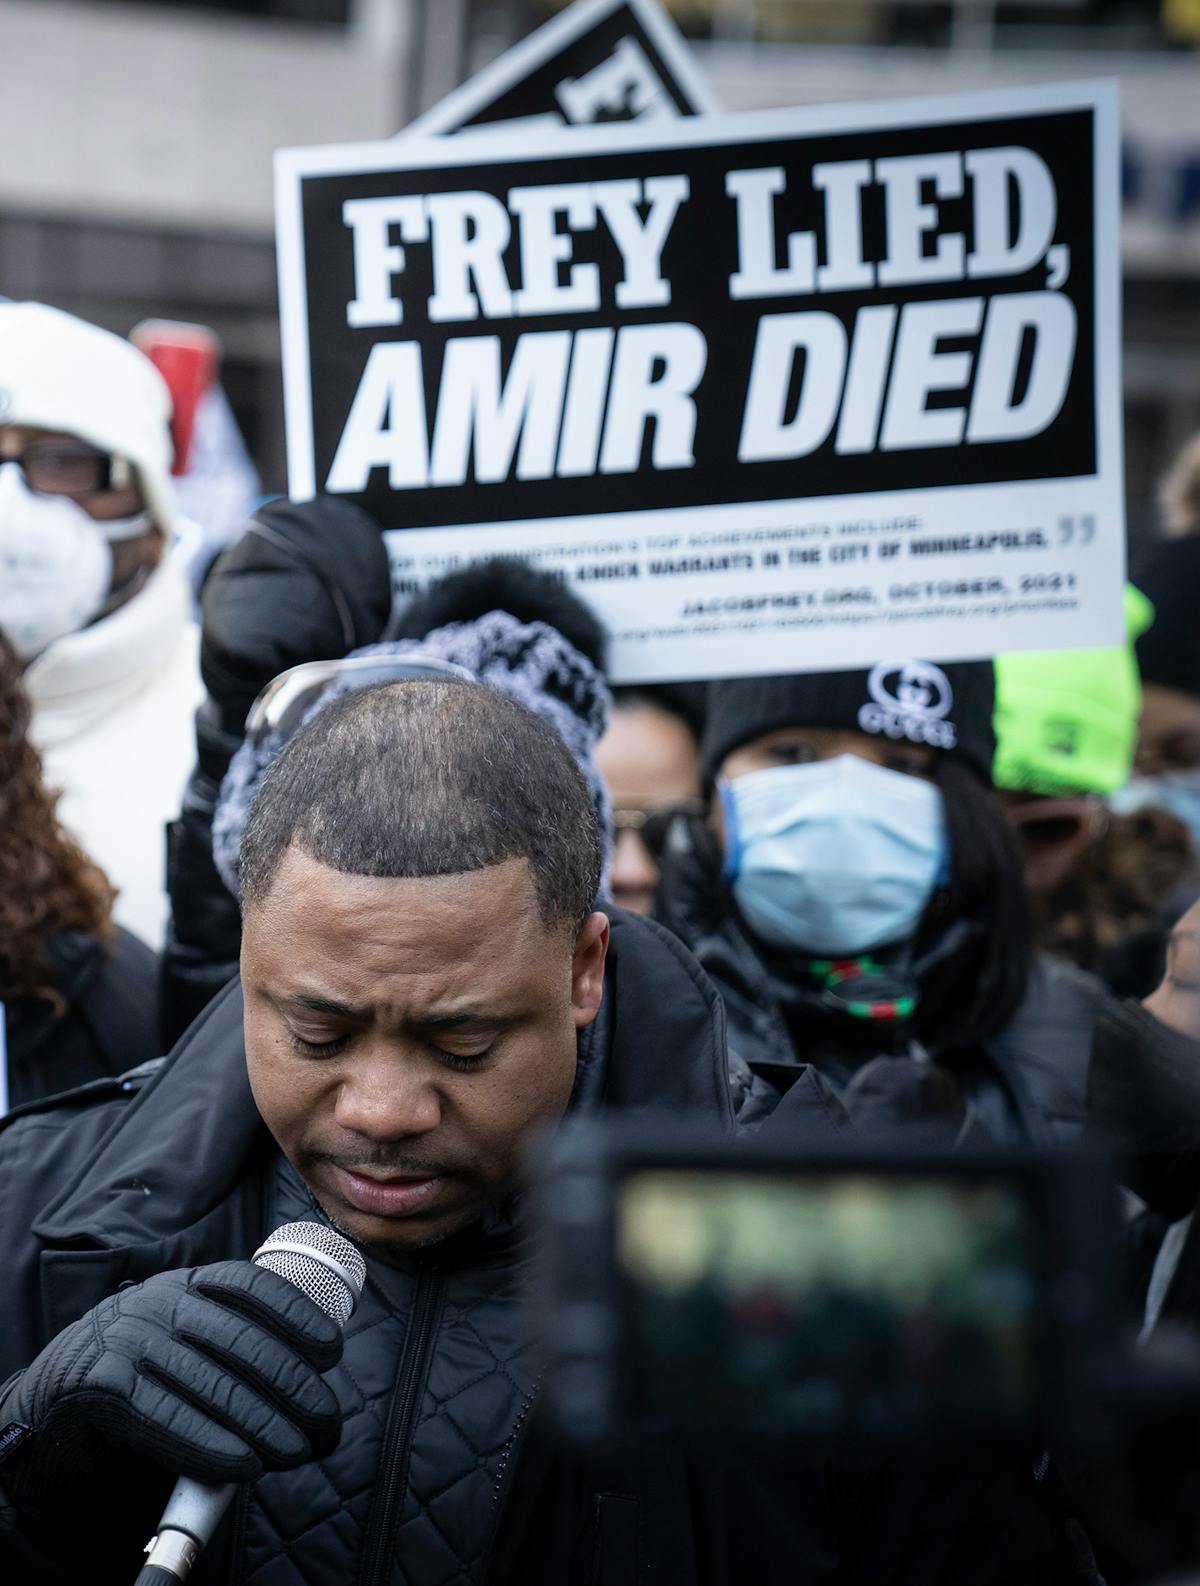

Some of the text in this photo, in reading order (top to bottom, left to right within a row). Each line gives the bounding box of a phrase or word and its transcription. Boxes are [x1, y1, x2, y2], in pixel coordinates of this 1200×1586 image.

[343, 176, 689, 327] FREY
[726, 147, 1069, 299] LIED,
[326, 291, 1077, 494] AMIR DIED
[828, 541, 869, 564] CITY
